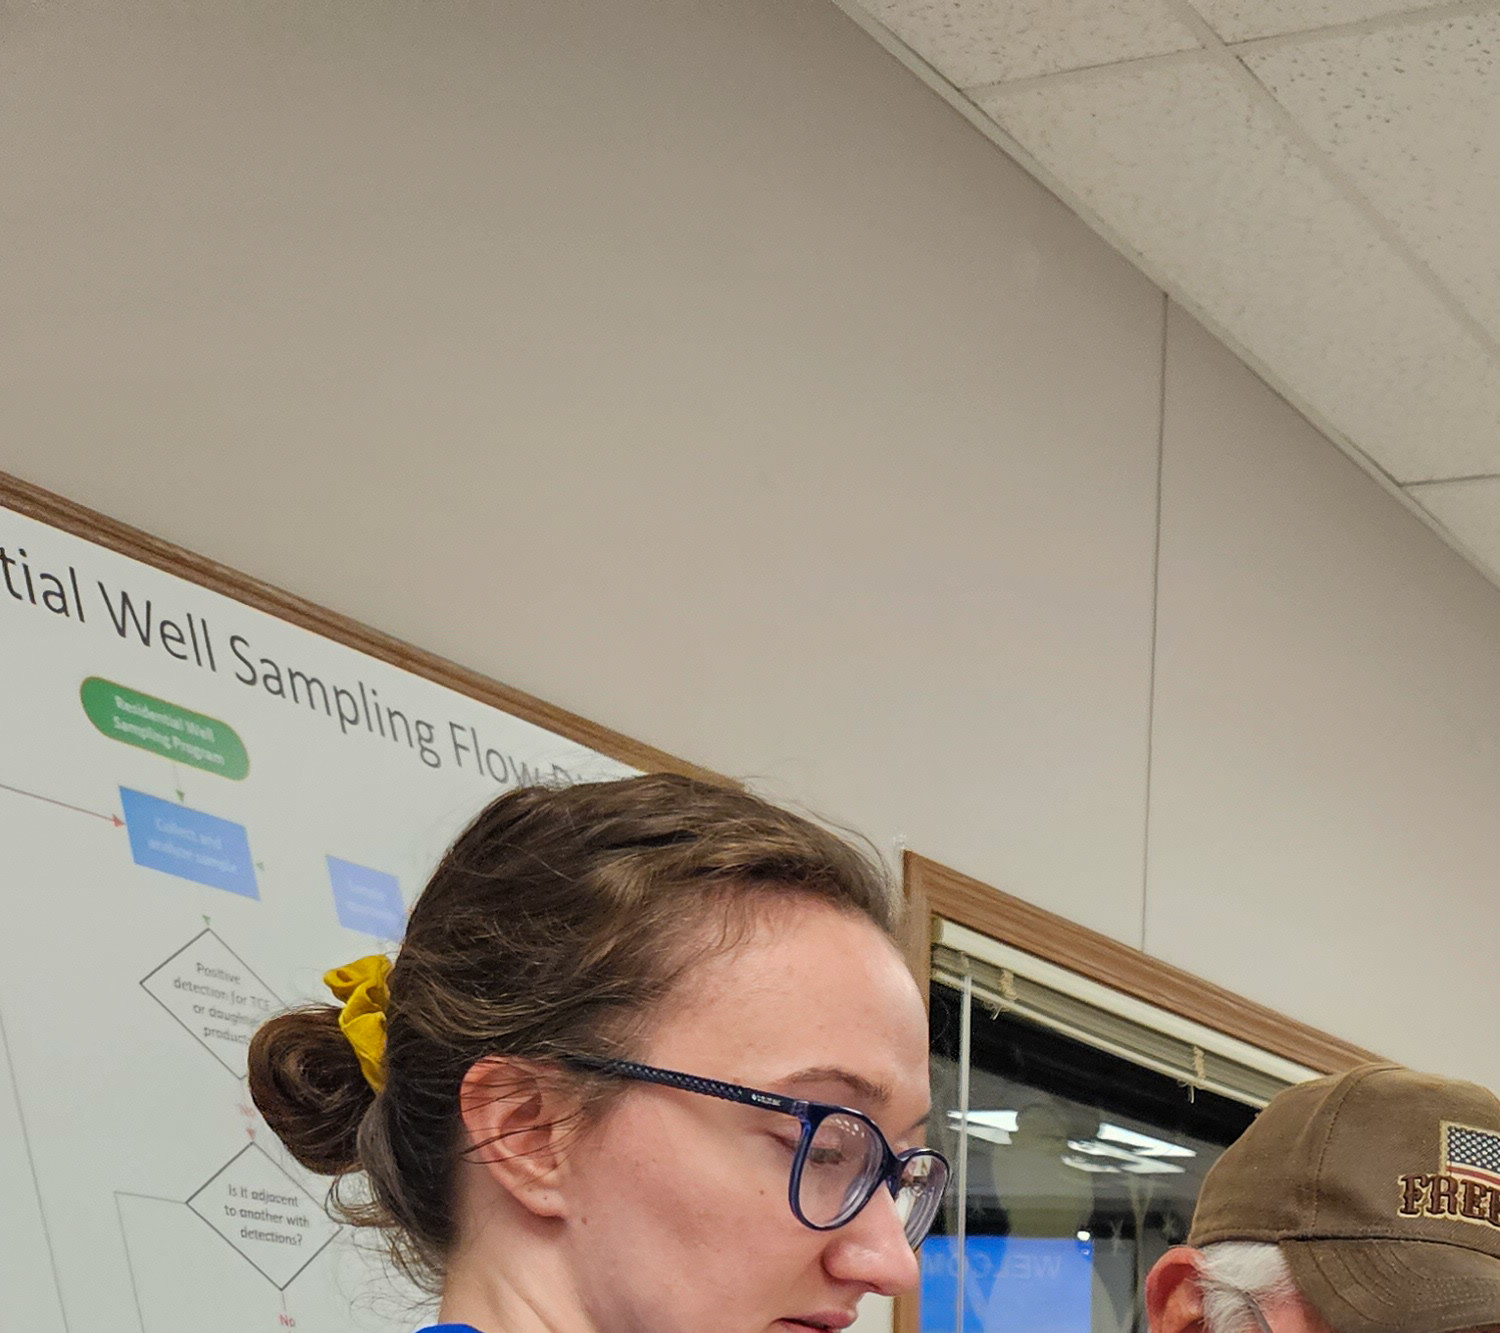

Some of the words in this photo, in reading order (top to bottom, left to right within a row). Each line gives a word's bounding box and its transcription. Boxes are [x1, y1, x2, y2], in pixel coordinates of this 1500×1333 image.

[0, 547, 85, 623] tial
[97, 580, 216, 672] Well
[230, 635, 442, 768] Sampling
[196, 961, 241, 985] Positive
[173, 976, 228, 1001] detection
[192, 1003, 206, 1015] or
[228, 1183, 238, 1198] Is
[240, 1185, 249, 1199] it
[251, 1187, 300, 1209] adjacent
[224, 1204, 237, 1217] to
[239, 1205, 284, 1225] another
[286, 1214, 311, 1229] with
[240, 1226, 303, 1247] detections?
[277, 1312, 296, 1328] No
